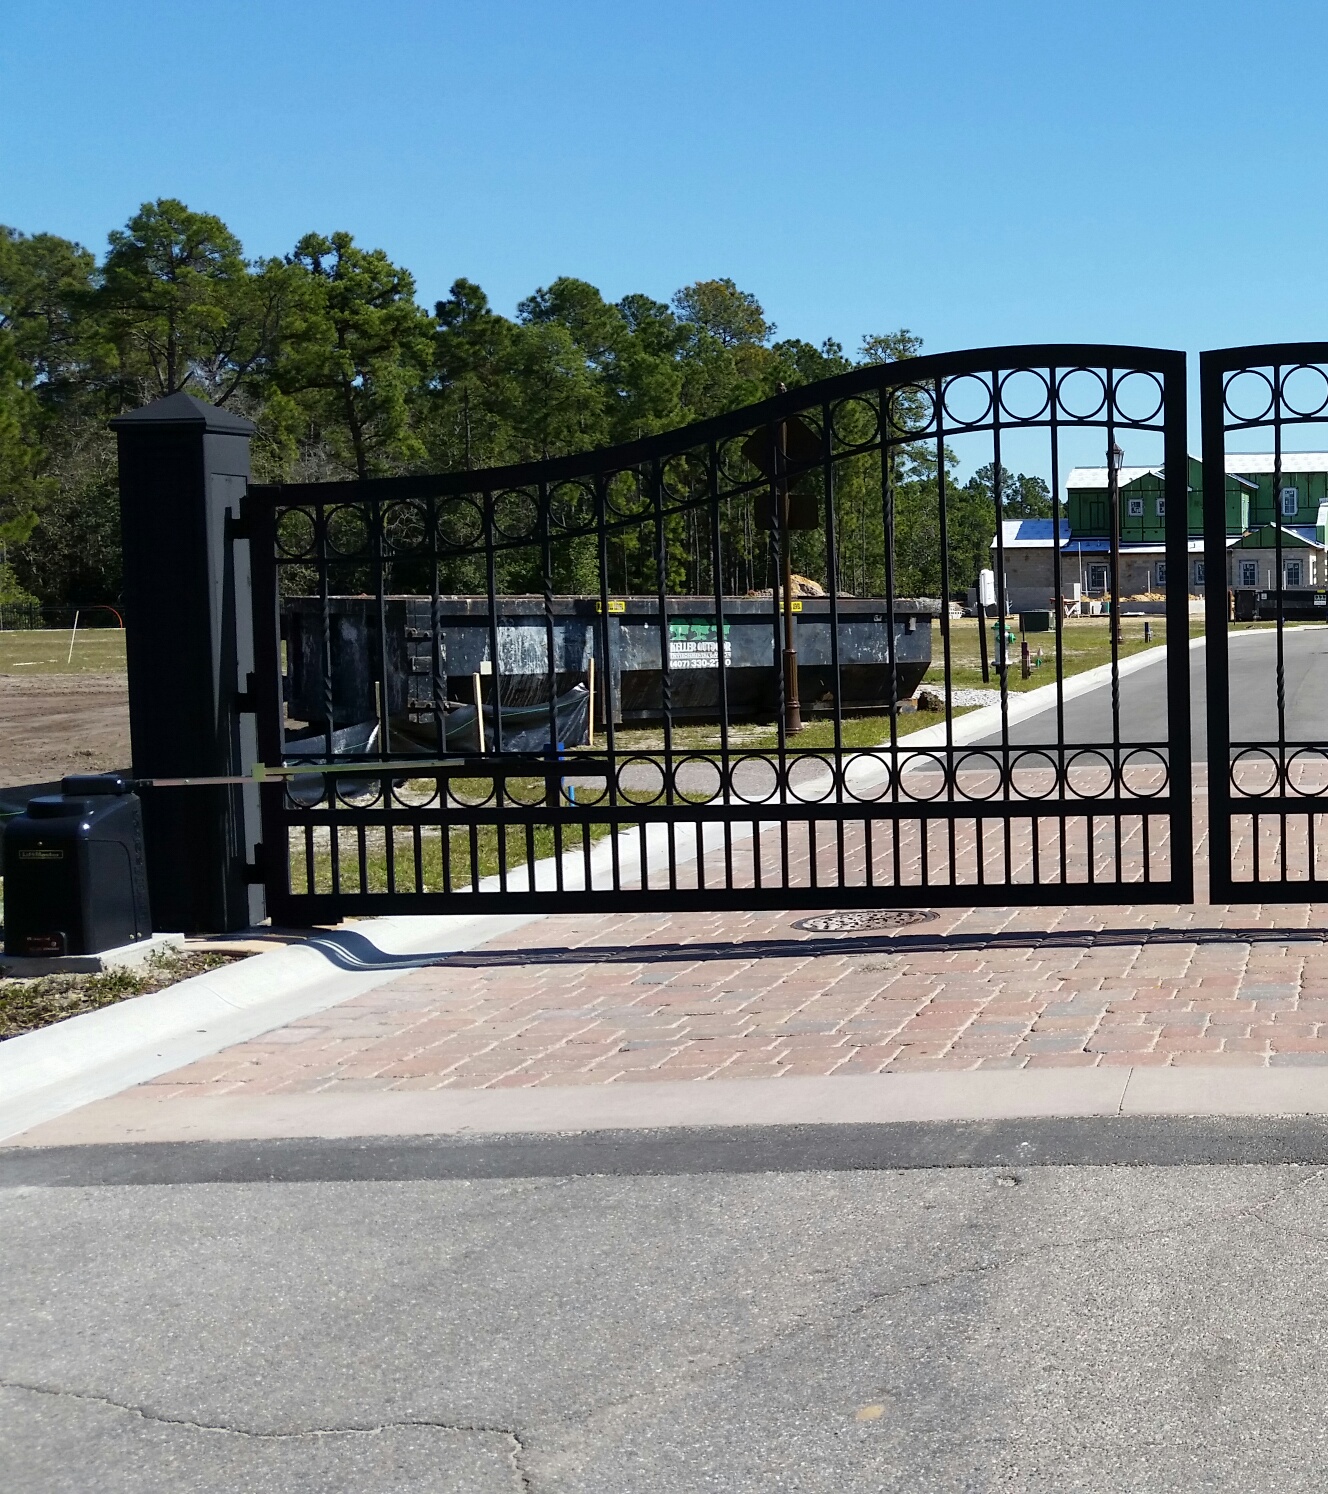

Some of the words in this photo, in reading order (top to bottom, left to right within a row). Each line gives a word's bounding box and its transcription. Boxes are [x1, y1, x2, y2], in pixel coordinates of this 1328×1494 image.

[669, 642, 697, 652] KELLER
[670, 660, 690, 668] (407)
[691, 659, 731, 667] 330-270
